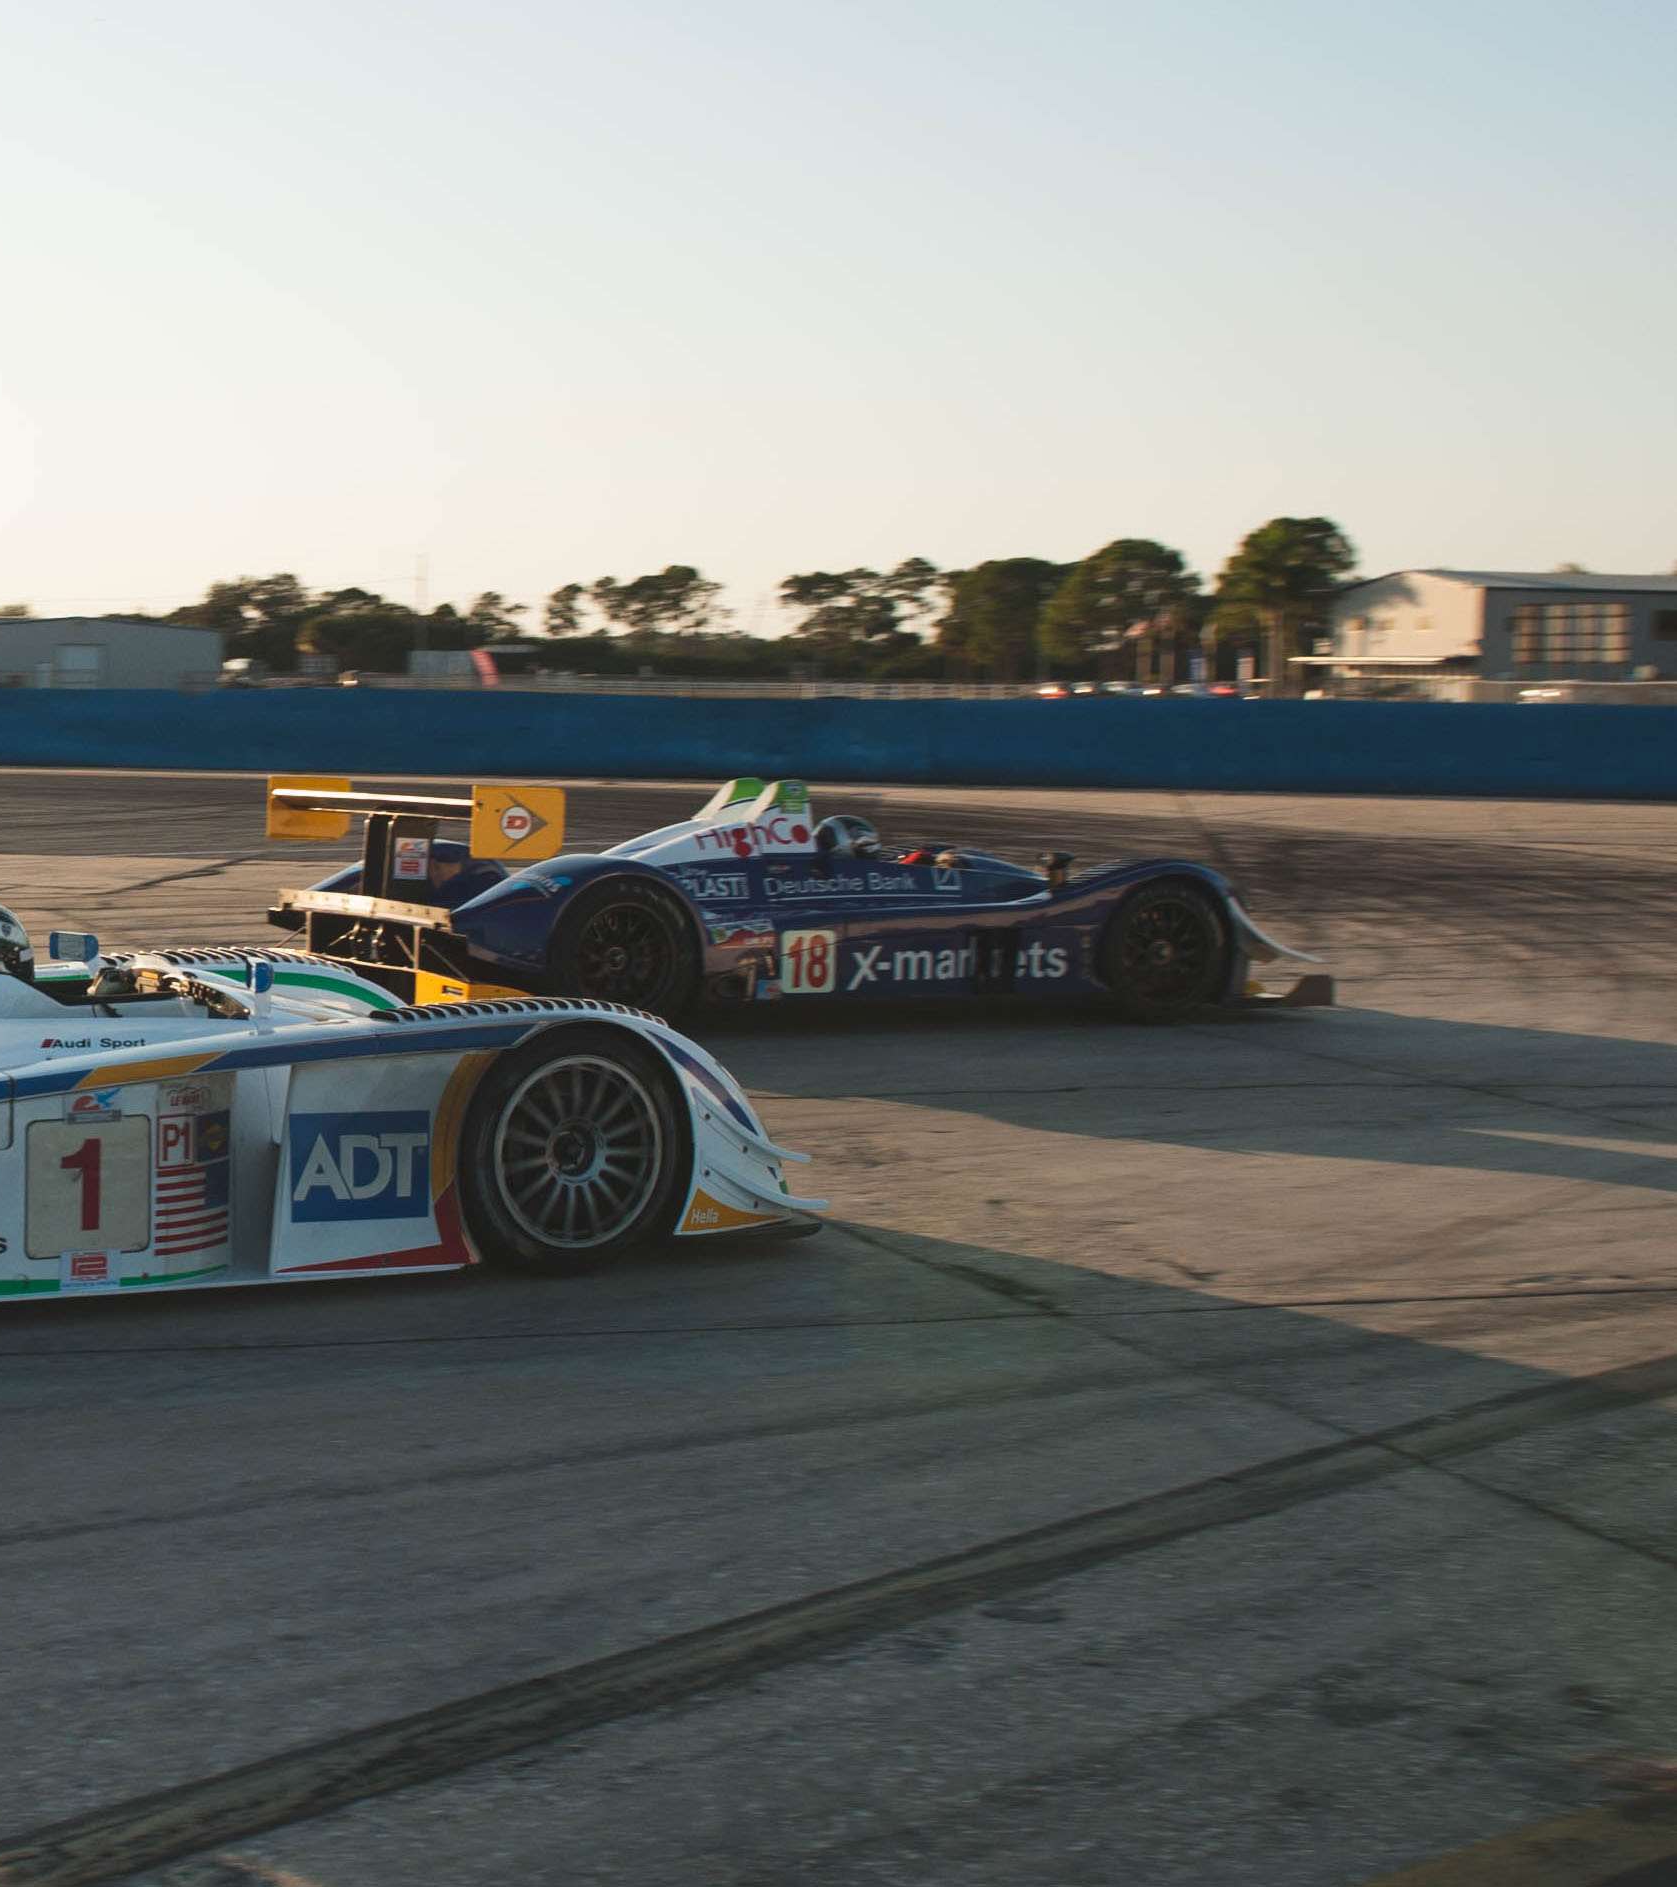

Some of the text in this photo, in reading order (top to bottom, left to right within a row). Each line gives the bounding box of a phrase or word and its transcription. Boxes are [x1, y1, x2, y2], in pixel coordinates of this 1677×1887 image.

[762, 871, 918, 896] Deutsche Bank
[788, 934, 829, 989] 18
[52, 1038, 146, 1050] Audi Sport
[61, 1138, 101, 1231] 1
[293, 1132, 428, 1202] ADT
